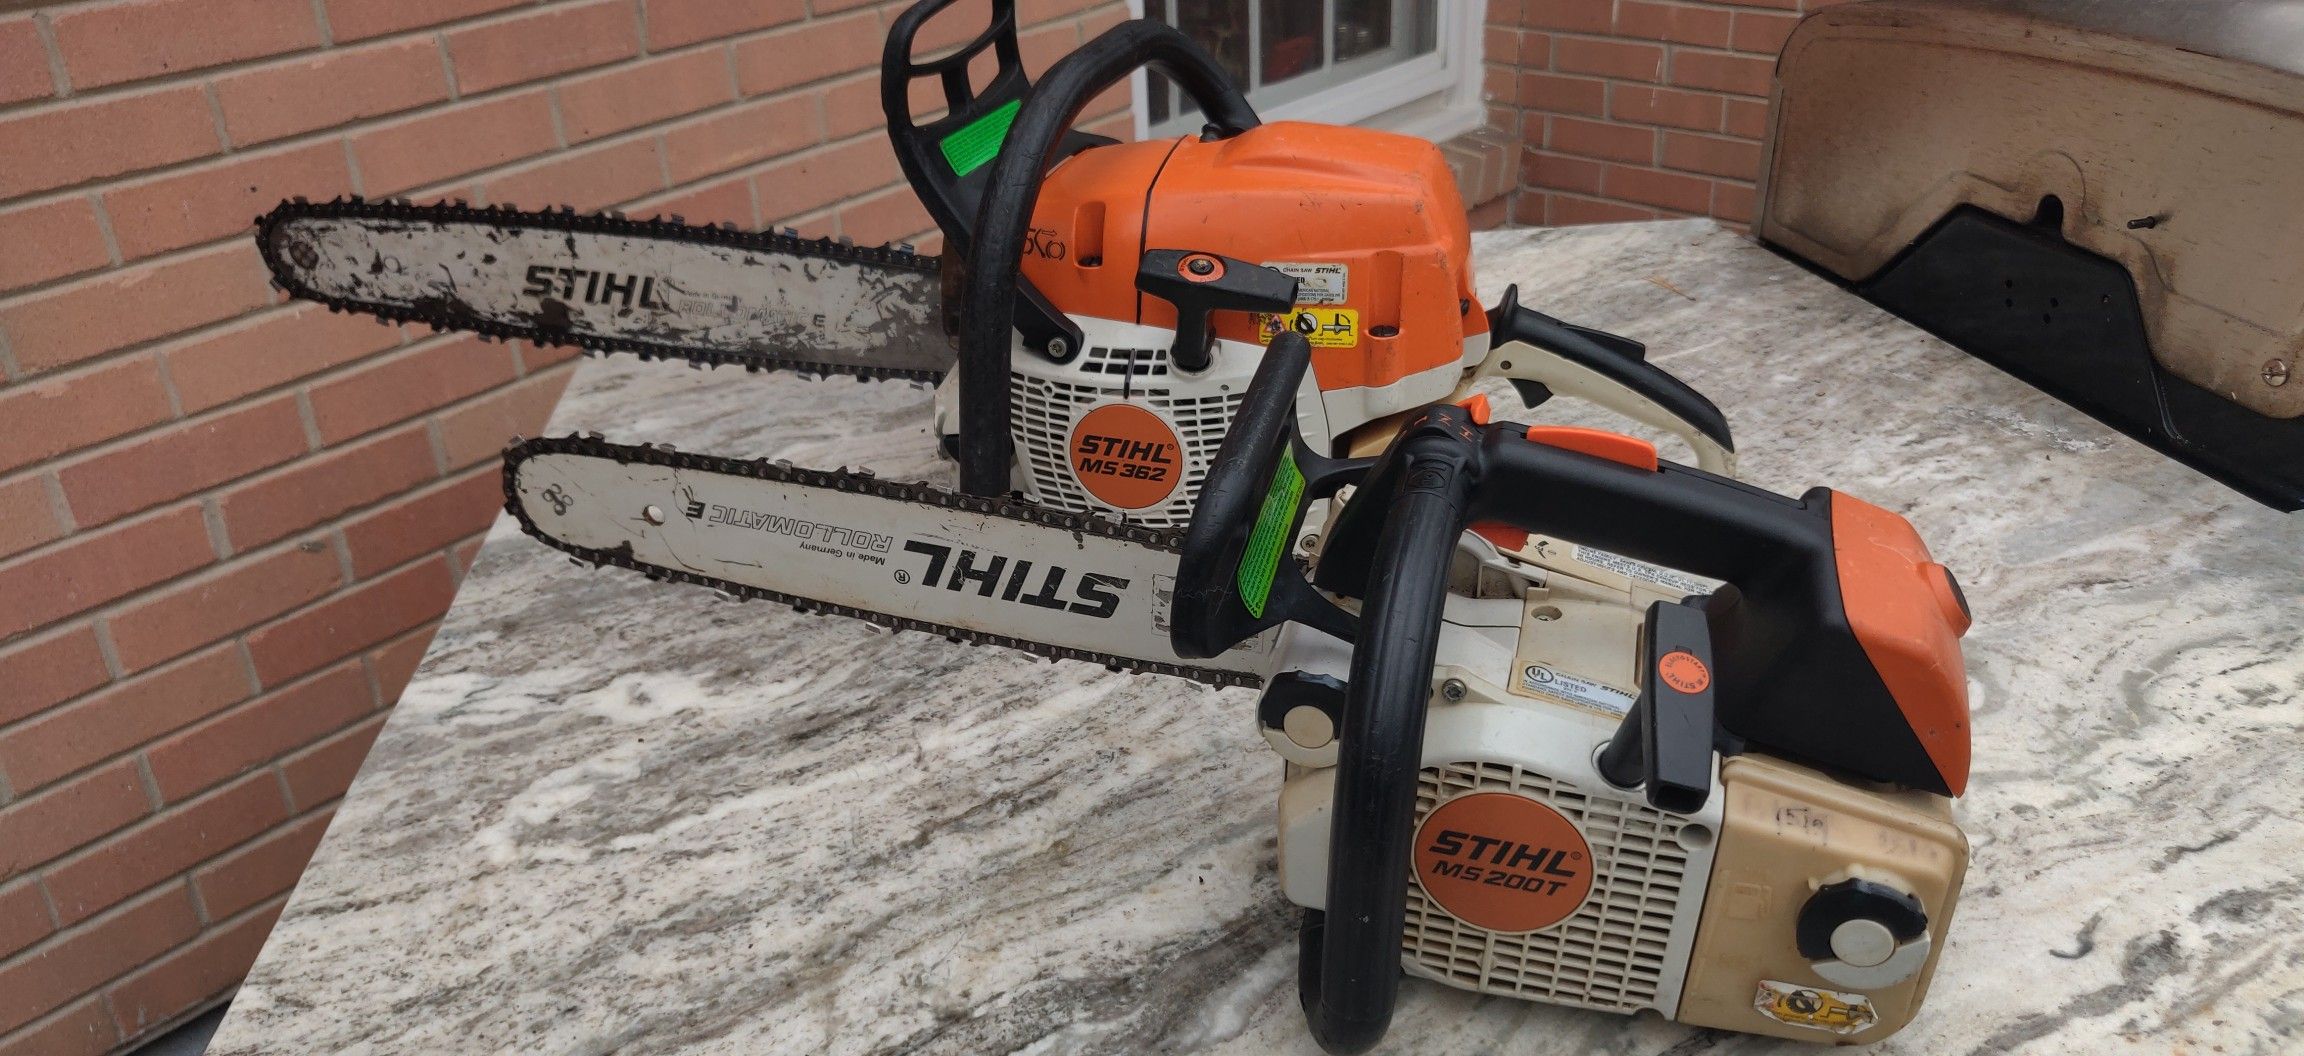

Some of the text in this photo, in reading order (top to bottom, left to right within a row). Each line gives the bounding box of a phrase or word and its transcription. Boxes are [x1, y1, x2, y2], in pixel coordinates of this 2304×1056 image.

[522, 265, 659, 309] STIHL
[1078, 434, 1172, 464] STIHL
[1079, 458, 1167, 482] MS 362
[709, 504, 893, 553] ROLLOMATIC
[799, 541, 886, 566] Made in Germany
[903, 539, 1131, 619] STIHL
[1531, 667, 1548, 681] UL
[1554, 678, 1587, 693] LISTED
[1600, 685, 1637, 700] STIHL
[1428, 829, 1576, 878] STIHL
[1432, 860, 1568, 896] MS 200T
